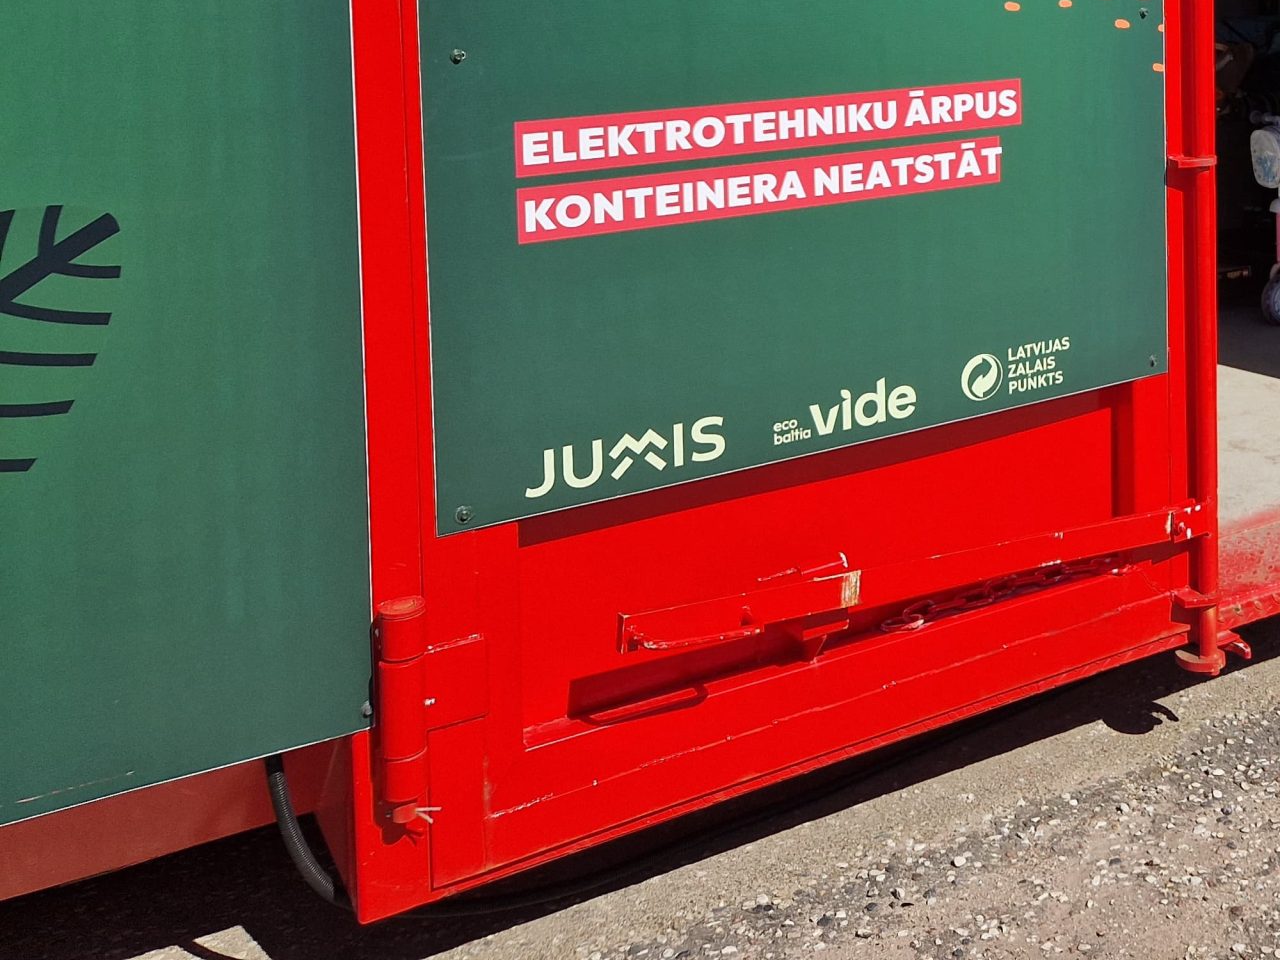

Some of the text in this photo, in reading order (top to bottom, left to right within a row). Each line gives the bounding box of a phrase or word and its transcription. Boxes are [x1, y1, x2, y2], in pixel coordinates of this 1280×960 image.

[522, 90, 1018, 166] ELEKTROTEHNIKU ĀRPUS
[524, 142, 1003, 233] KONTEINERA NEATSTĀT
[1008, 336, 1071, 362] LATVIJAS
[1008, 371, 1064, 395] PUNKTS
[773, 377, 917, 446] baltia vide
[773, 419, 798, 432] eco
[525, 415, 726, 499] JUMIS
